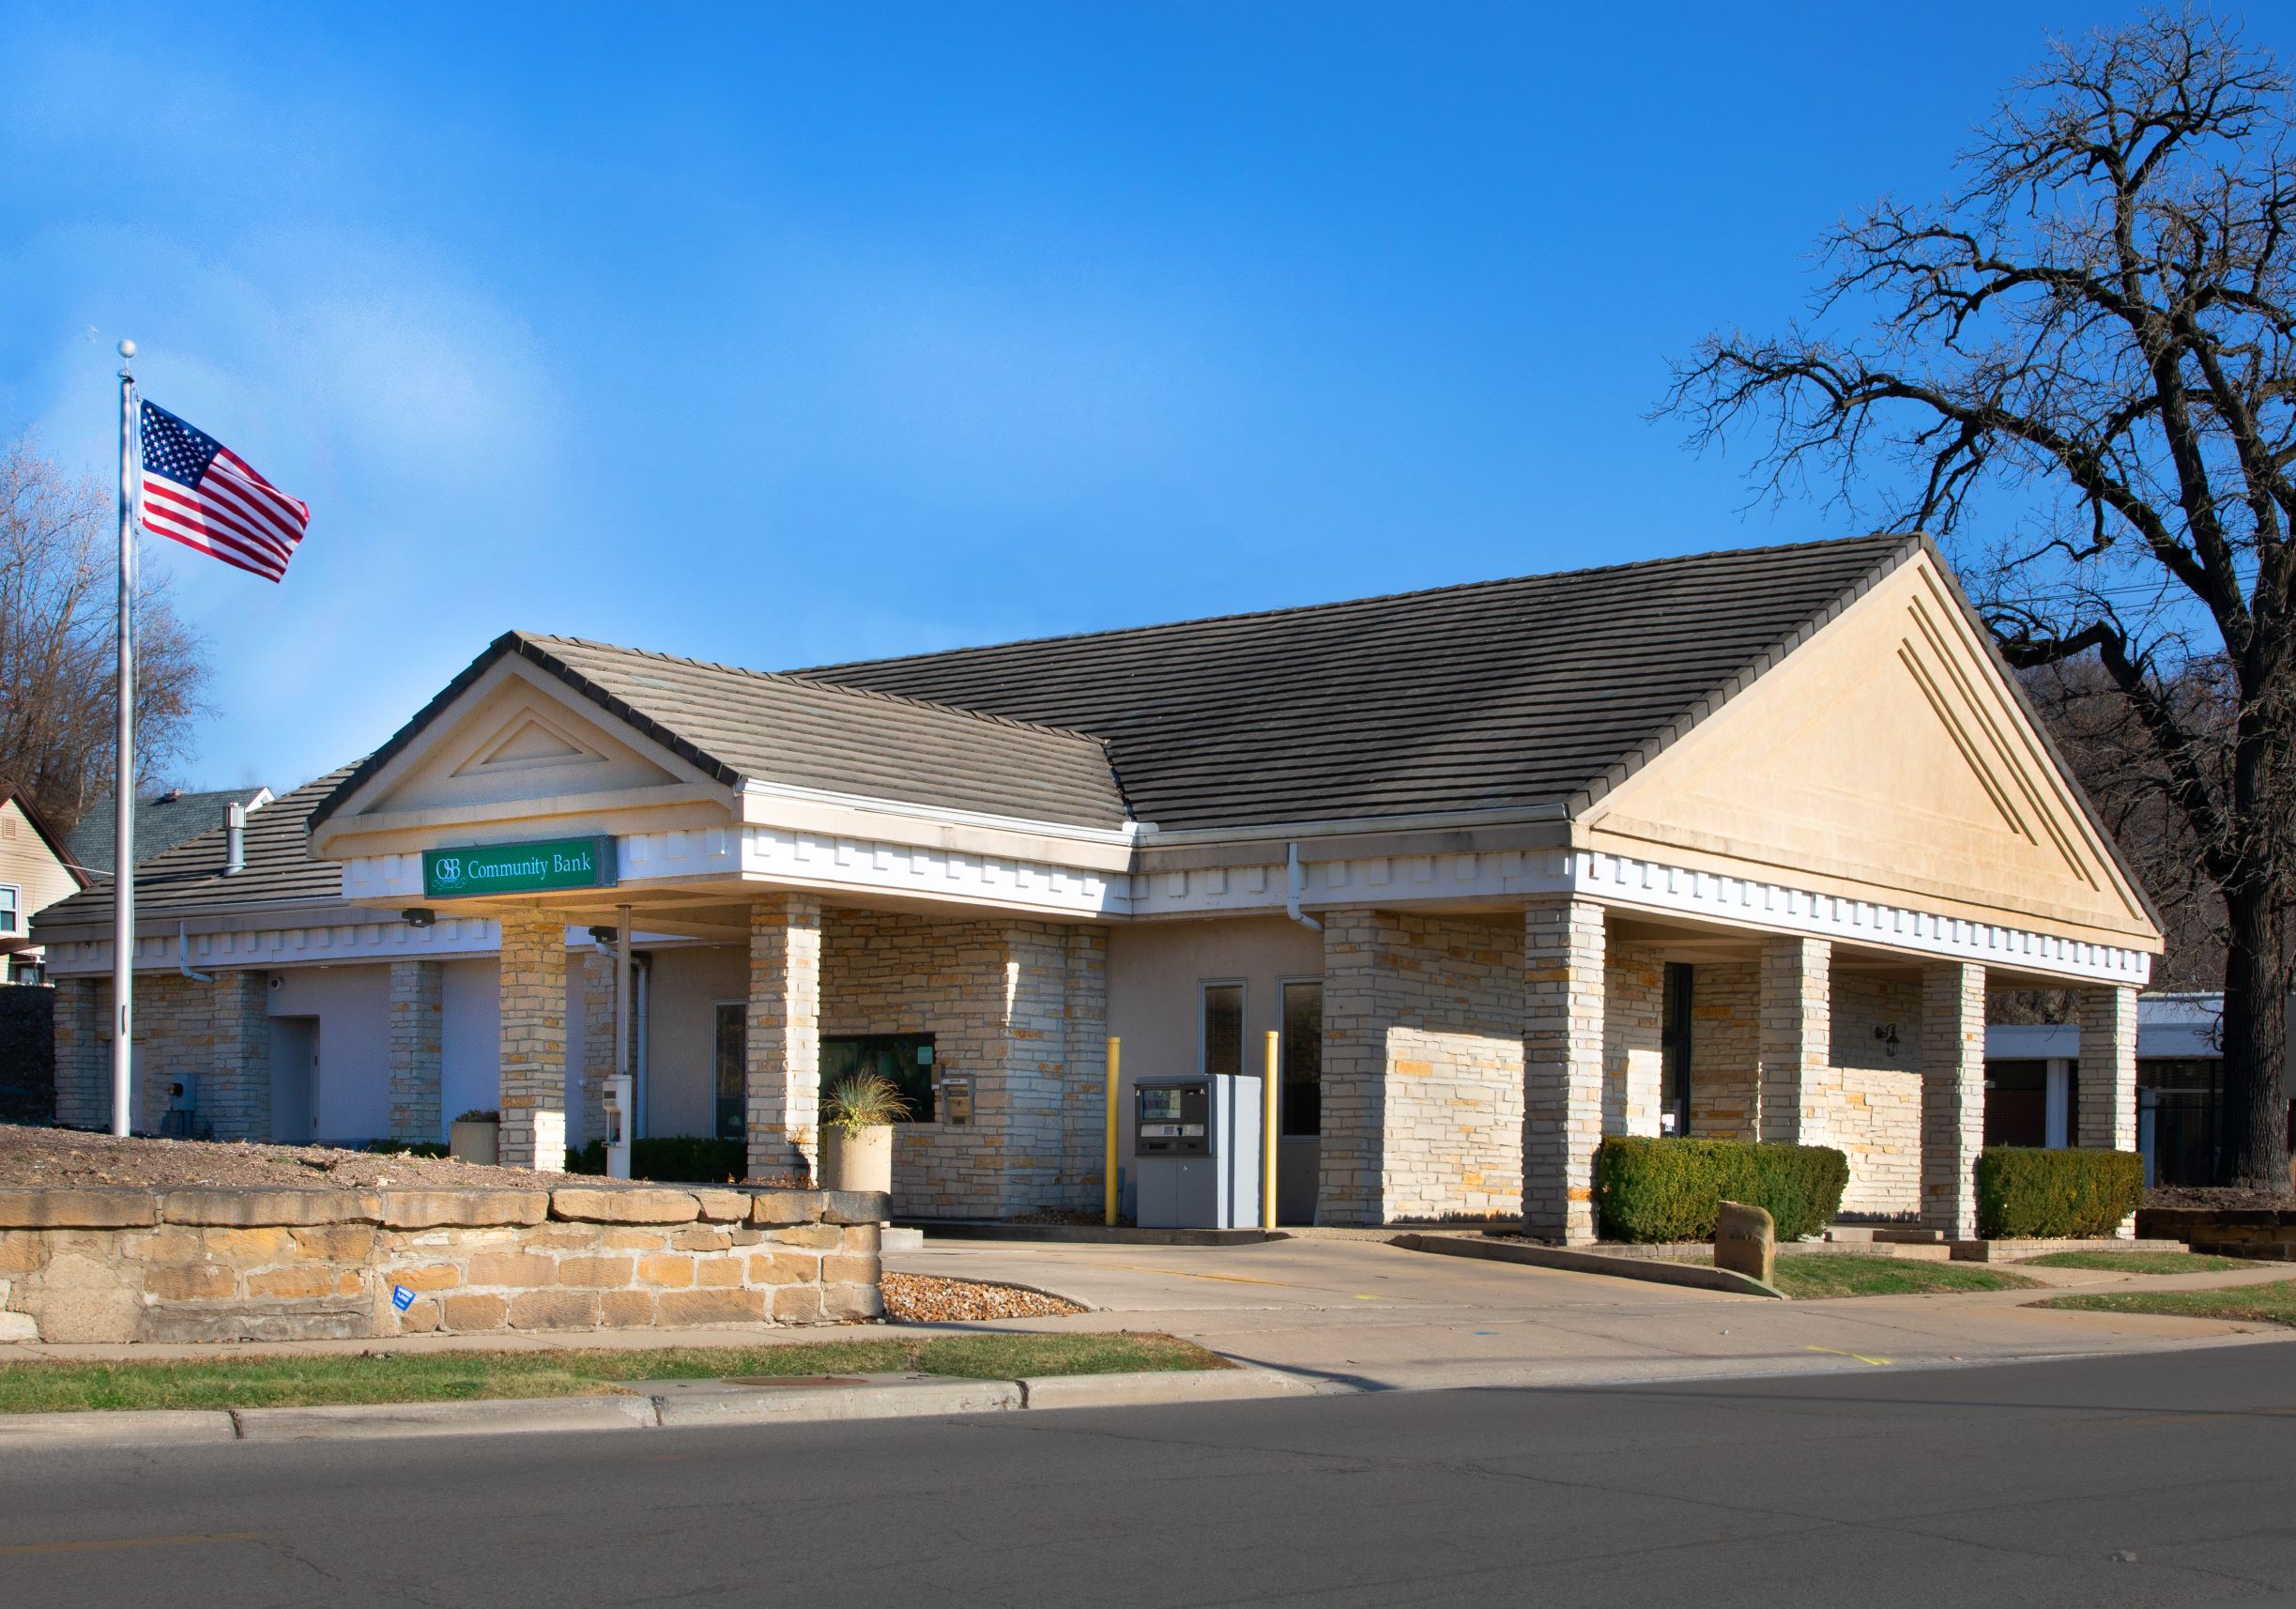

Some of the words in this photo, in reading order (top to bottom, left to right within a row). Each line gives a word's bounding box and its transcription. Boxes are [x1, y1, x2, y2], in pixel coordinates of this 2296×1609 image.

[436, 858, 461, 880] CSB
[468, 856, 548, 881] Community
[553, 851, 591, 873] Bank
